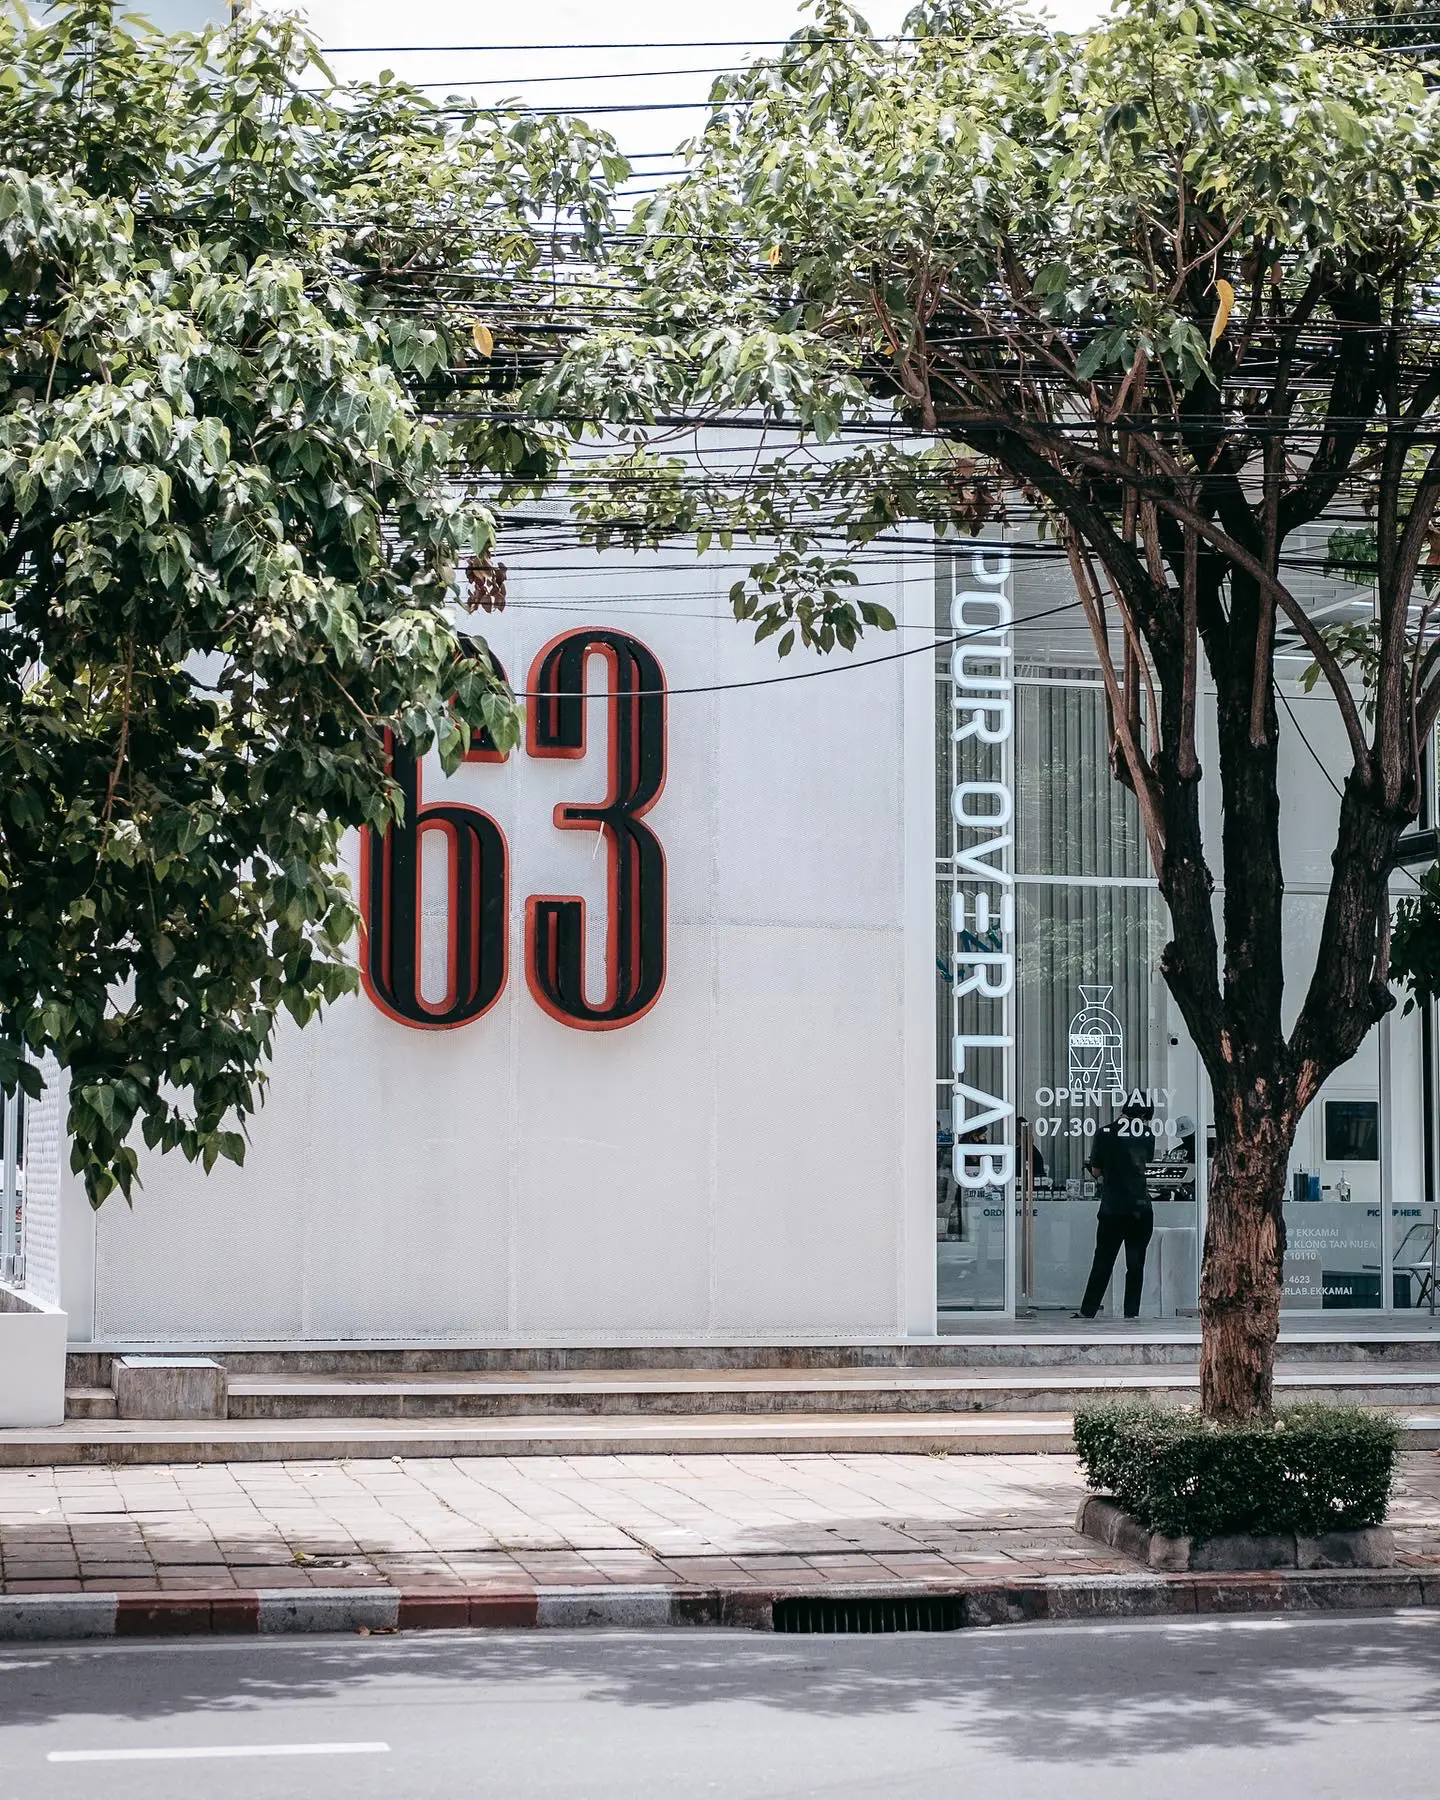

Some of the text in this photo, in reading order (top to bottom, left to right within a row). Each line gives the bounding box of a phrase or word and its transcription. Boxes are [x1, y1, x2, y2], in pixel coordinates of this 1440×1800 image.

[360, 626, 668, 1031] 63
[951, 781, 1014, 998] OVER
[1035, 1087, 1177, 1107] OPEN DAILY
[951, 1035, 1014, 1189] LAB
[1035, 1117, 1097, 1137] 07.30
[1117, 1117, 1177, 1137] 20.00
[1400, 1208, 1422, 1217] HERE
[1296, 1228, 1339, 1237] EKKAMAI
[1294, 1240, 1327, 1249] KLONG
[1329, 1240, 1347, 1249] TAN
[1289, 1251, 1317, 1260] 10110
[1288, 1275, 1311, 1284] 4623
